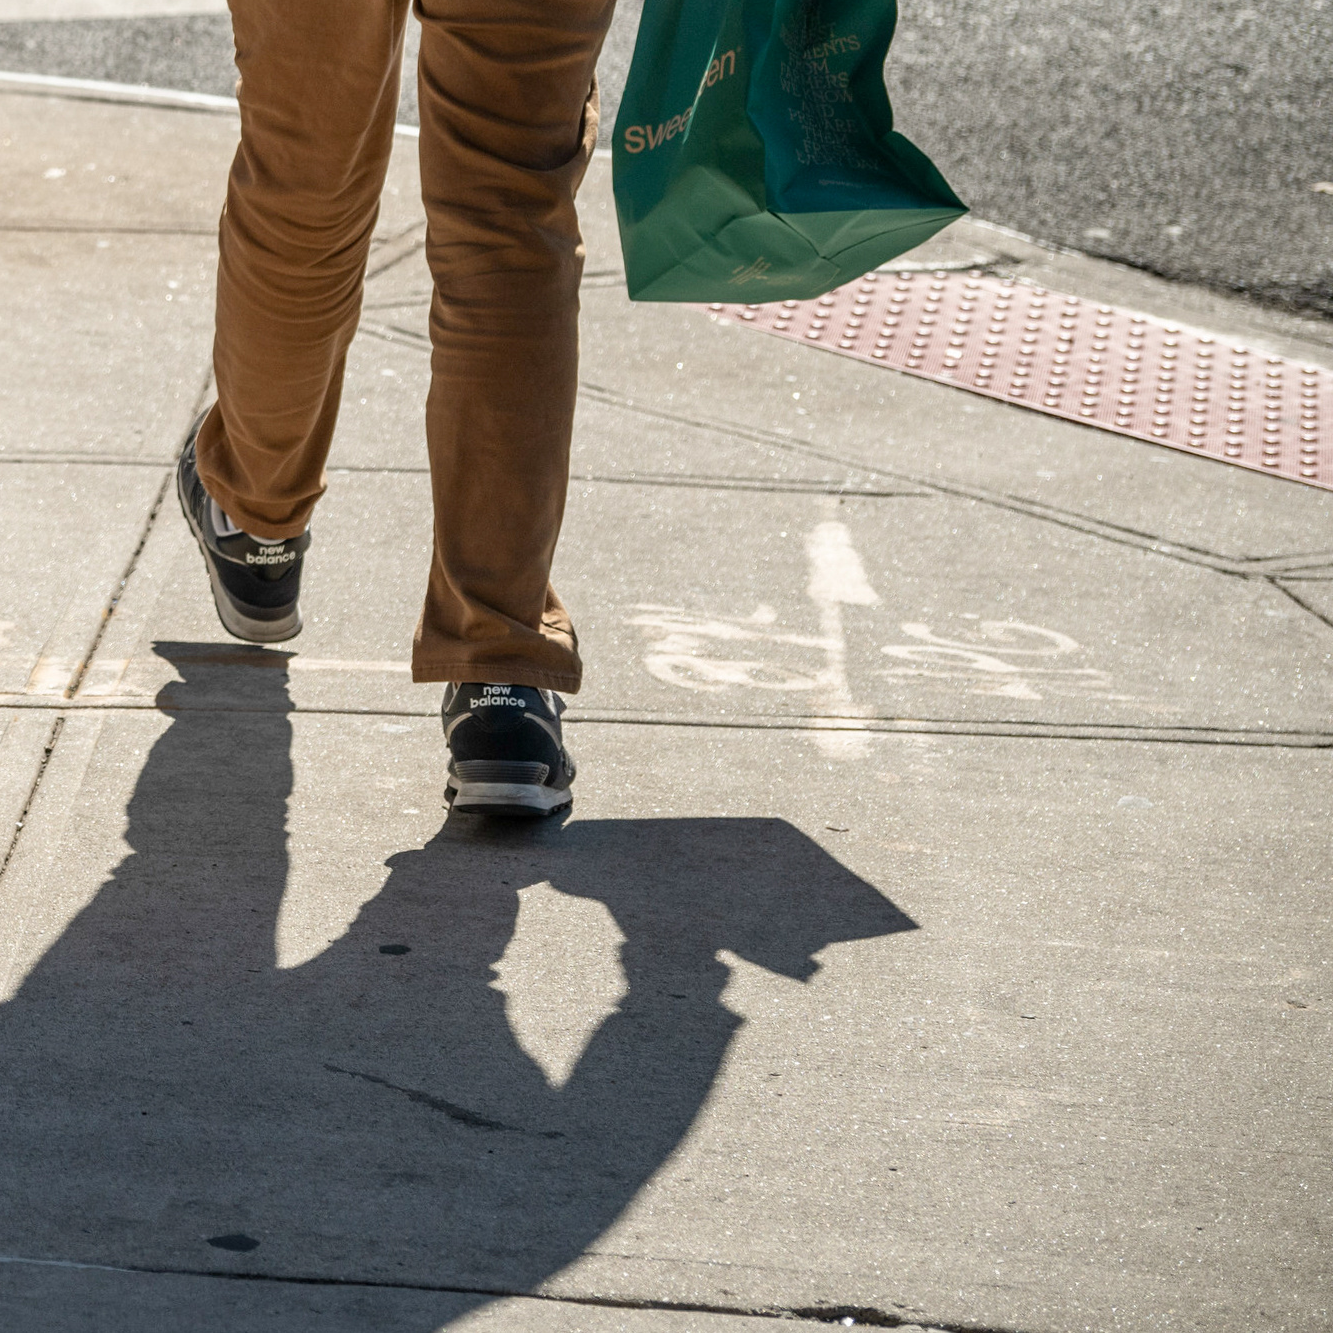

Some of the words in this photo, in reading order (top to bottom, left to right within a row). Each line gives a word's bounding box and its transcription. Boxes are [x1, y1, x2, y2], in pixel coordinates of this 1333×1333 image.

[259, 544, 285, 556] new
[246, 549, 296, 566] balance
[483, 685, 512, 696] new
[470, 694, 527, 709] balance
